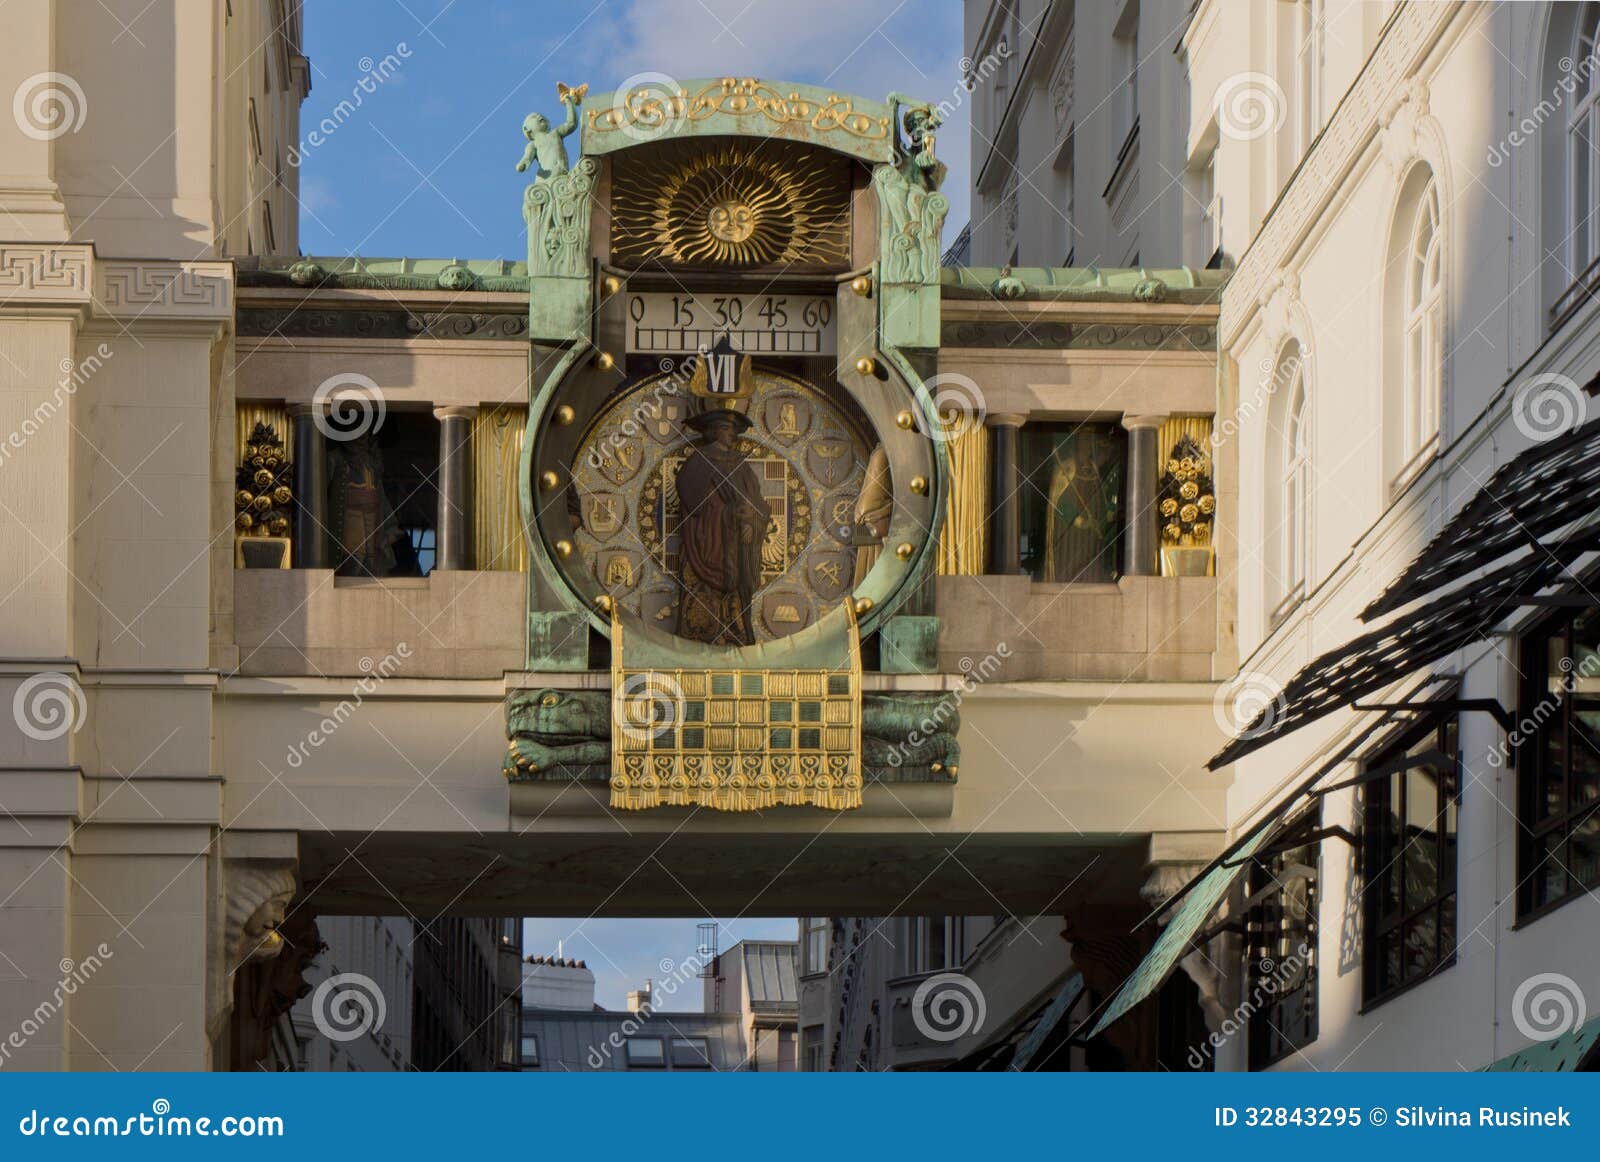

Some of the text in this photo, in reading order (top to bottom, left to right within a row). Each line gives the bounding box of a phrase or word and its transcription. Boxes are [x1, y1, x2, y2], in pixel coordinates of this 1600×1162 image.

[630, 295, 832, 328] 0 15 30 45 60
[707, 354, 736, 393] VII
